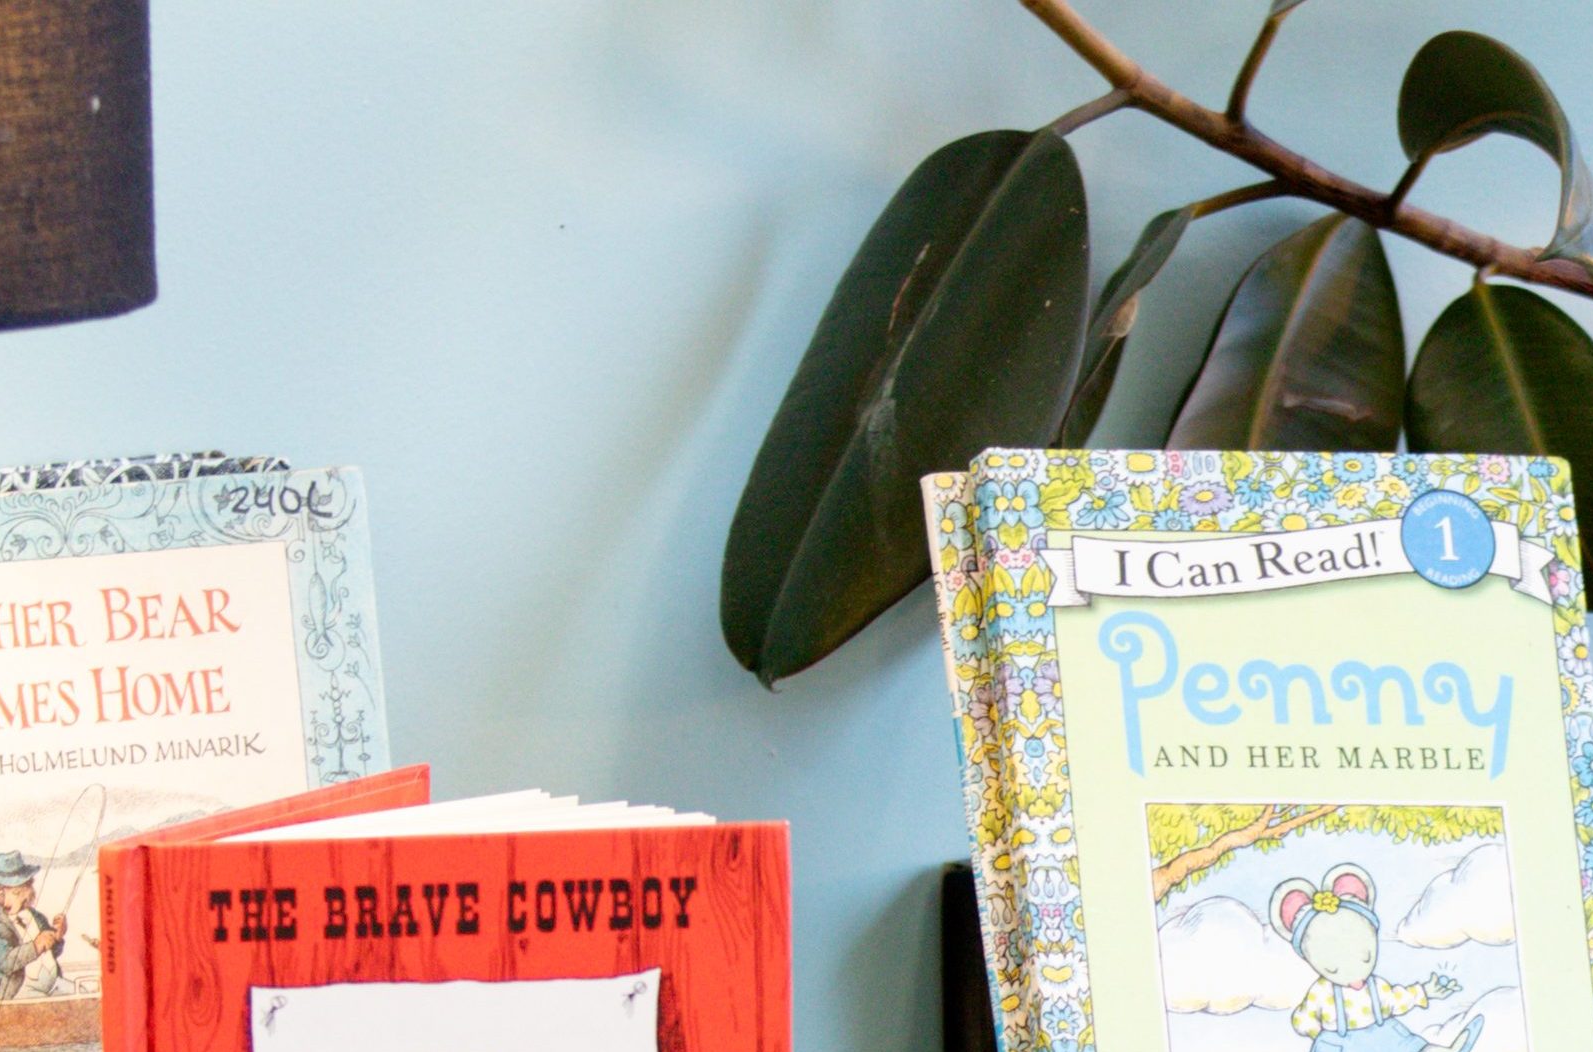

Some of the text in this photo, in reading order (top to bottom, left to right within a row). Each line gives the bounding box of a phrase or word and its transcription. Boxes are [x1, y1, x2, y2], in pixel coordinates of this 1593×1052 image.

[1412, 495, 1479, 519] BEGINNING
[1113, 531, 1382, 589] I Can Read!
[1434, 516, 1461, 561] 1
[1426, 568, 1479, 585] READING
[100, 587, 241, 643] BEAR
[89, 665, 231, 724] HOME
[1098, 610, 1514, 781] Penny
[0, 743, 147, 775] HOLMELUND
[155, 732, 266, 763] MINARIK
[1154, 746, 1486, 770] AND HER MARBLE
[209, 876, 697, 942] THE BRAVE COWBOY
